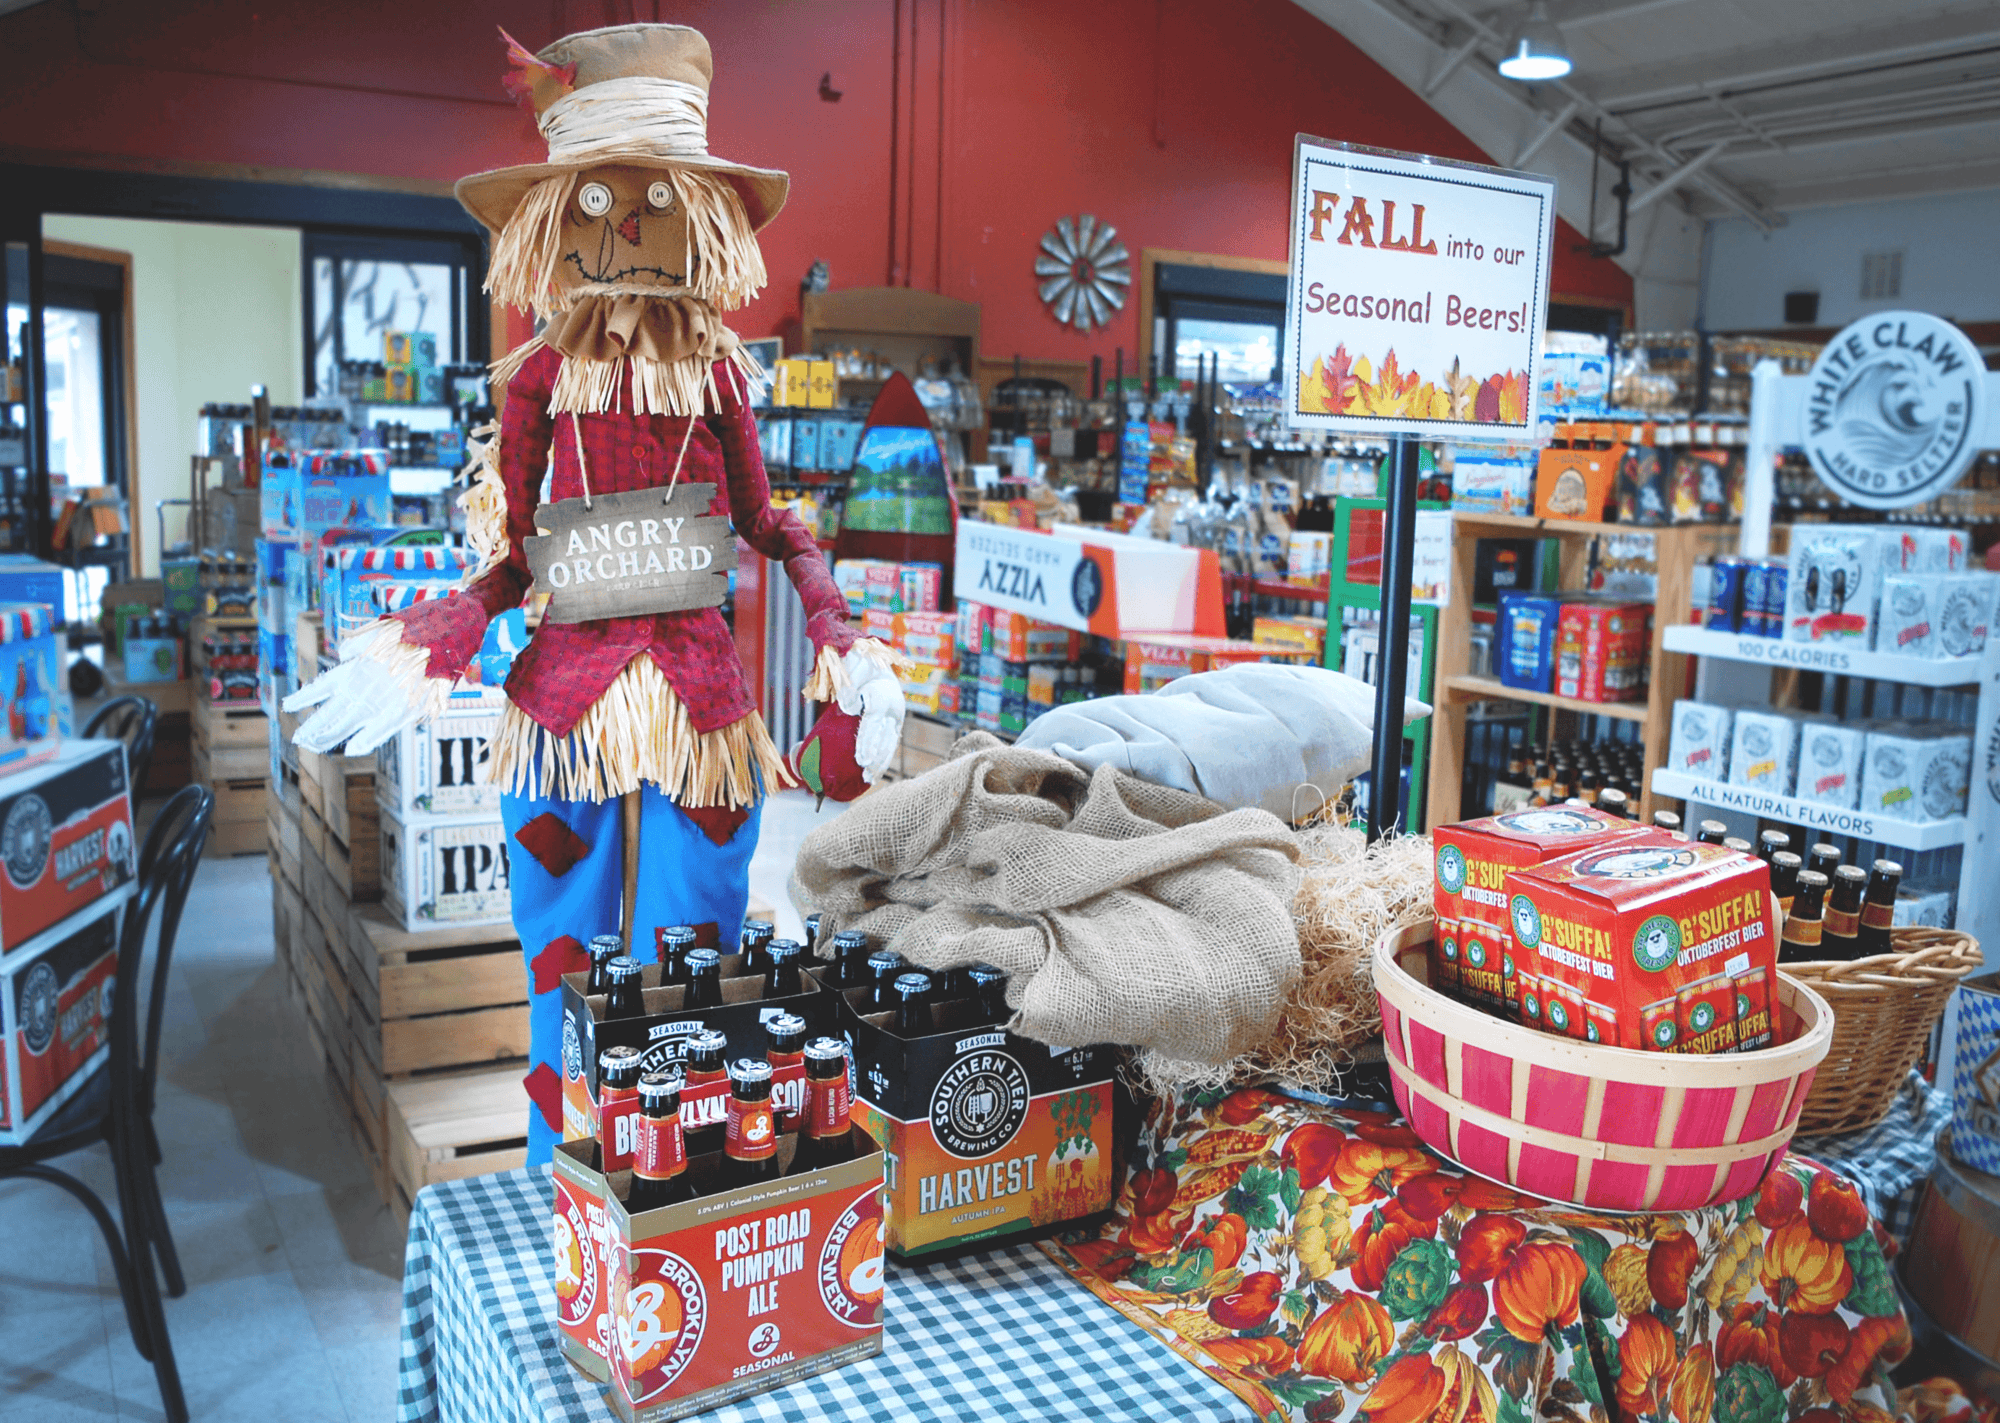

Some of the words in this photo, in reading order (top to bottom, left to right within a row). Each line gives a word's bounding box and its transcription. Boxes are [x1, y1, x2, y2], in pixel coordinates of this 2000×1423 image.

[1309, 189, 1438, 256] FALL
[1446, 234, 1484, 261] into
[1493, 246, 1525, 266] our
[1305, 281, 1432, 324] Seasonal
[1446, 294, 1527, 334] Beers!
[1809, 333, 1868, 437] WHITE
[1873, 321, 1965, 376] CLAW
[1833, 452, 1887, 488] HARD
[1897, 401, 1963, 487] SELTZER
[565, 516, 685, 557] ANGRY
[547, 544, 714, 588] ORCHARD
[978, 559, 1047, 606] VIZZY
[1738, 640, 1765, 657] 100
[1768, 645, 1850, 670] CALORIES
[1691, 785, 1716, 801] ALL
[1722, 791, 1793, 818] NATURAL
[1799, 807, 1874, 835] FLAVORS
[439, 842, 511, 896] IPA
[1462, 885, 1508, 909] OKTOBERFES
[1680, 889, 1762, 947] G'SUFFA!
[1540, 913, 1613, 961] G'SUFFA!
[1677, 928, 1741, 967] OKTOBERFEST
[1742, 921, 1765, 943] BIER
[1538, 941, 1591, 974] OKTOBERFEST
[1592, 960, 1615, 981] BIER
[653, 1022, 699, 1037] SEASONAL
[959, 1035, 1002, 1051] SEASONAL
[1072, 1051, 1084, 1065] 6.7
[935, 1056, 1007, 1127] SOUTHERN
[1006, 1068, 1025, 1111] TIER
[947, 1134, 997, 1152] BREWING
[998, 1123, 1012, 1139] CO
[730, 1197, 752, 1208] Colonial
[752, 1193, 766, 1202] Style
[766, 1188, 788, 1200] Pumpkin
[788, 1185, 800, 1193] Beer
[919, 1153, 1038, 1216] HARVEST
[716, 1220, 761, 1261] POST
[765, 1208, 811, 1248] ROAD
[951, 1209, 990, 1225] AUTUMN
[991, 1205, 1006, 1215] IPA
[567, 1205, 595, 1320] BROOKLYN
[722, 1241, 804, 1292] PUMPKIN
[823, 1210, 860, 1319] BREWERY
[657, 1257, 704, 1378] BROOKLYN
[748, 1280, 779, 1317] ALE
[733, 1351, 795, 1379] SEASONAL
